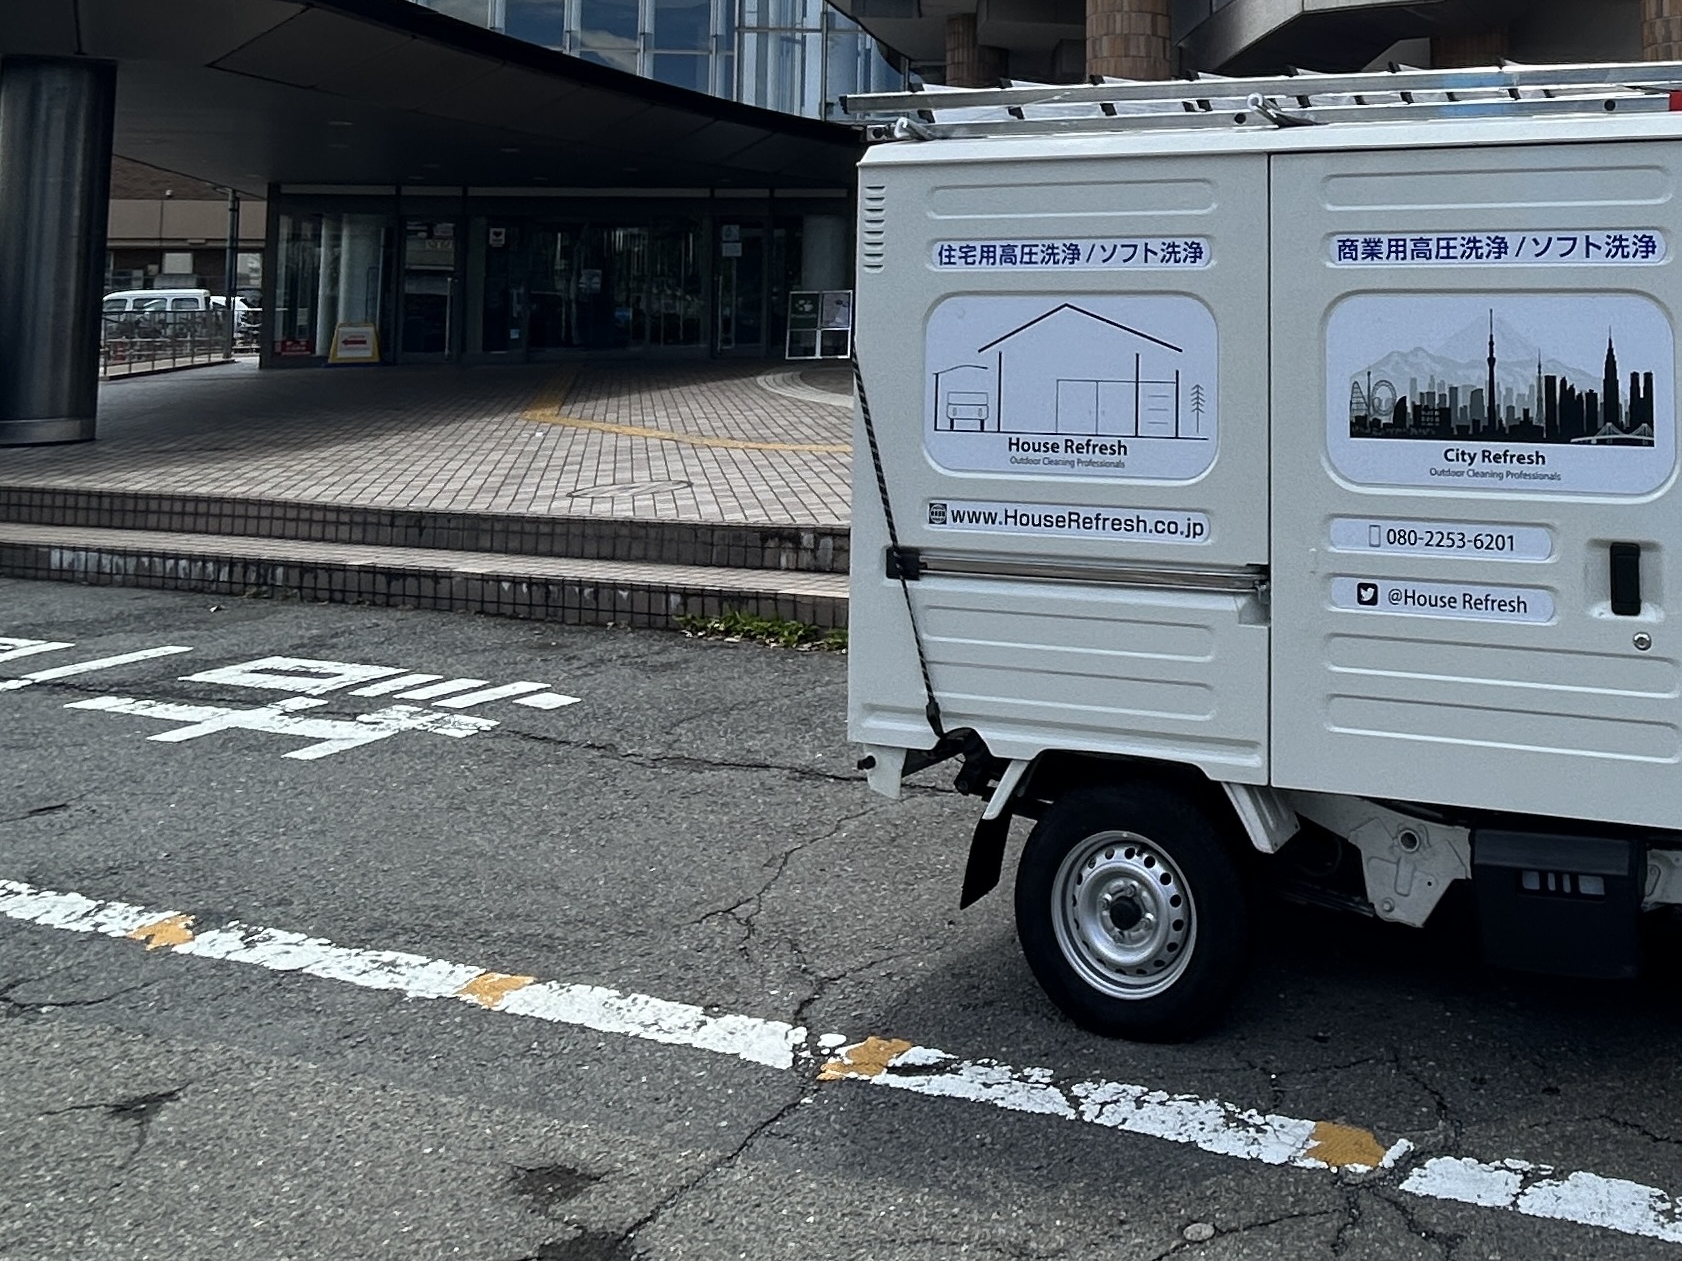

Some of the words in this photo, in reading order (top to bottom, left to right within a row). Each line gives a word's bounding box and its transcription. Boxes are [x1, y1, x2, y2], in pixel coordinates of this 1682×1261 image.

[1008, 437, 1060, 453] House
[1064, 438, 1128, 456] Refresh
[1009, 455, 1041, 466] Outdoor
[1042, 457, 1076, 469] Cleaning
[1076, 458, 1126, 469] Professionals
[1443, 448, 1477, 466] City
[1481, 449, 1546, 465] Refresh
[1429, 467, 1465, 478] Outdoor
[1466, 468, 1504, 481] Cleaning
[1505, 470, 1562, 481] Professionals
[951, 508, 1204, 539] www.HouseRefresh.co.jp
[1386, 528, 1516, 551] 080-2253-6201
[1387, 588, 1458, 609] @House
[1462, 592, 1528, 614] Refresh
